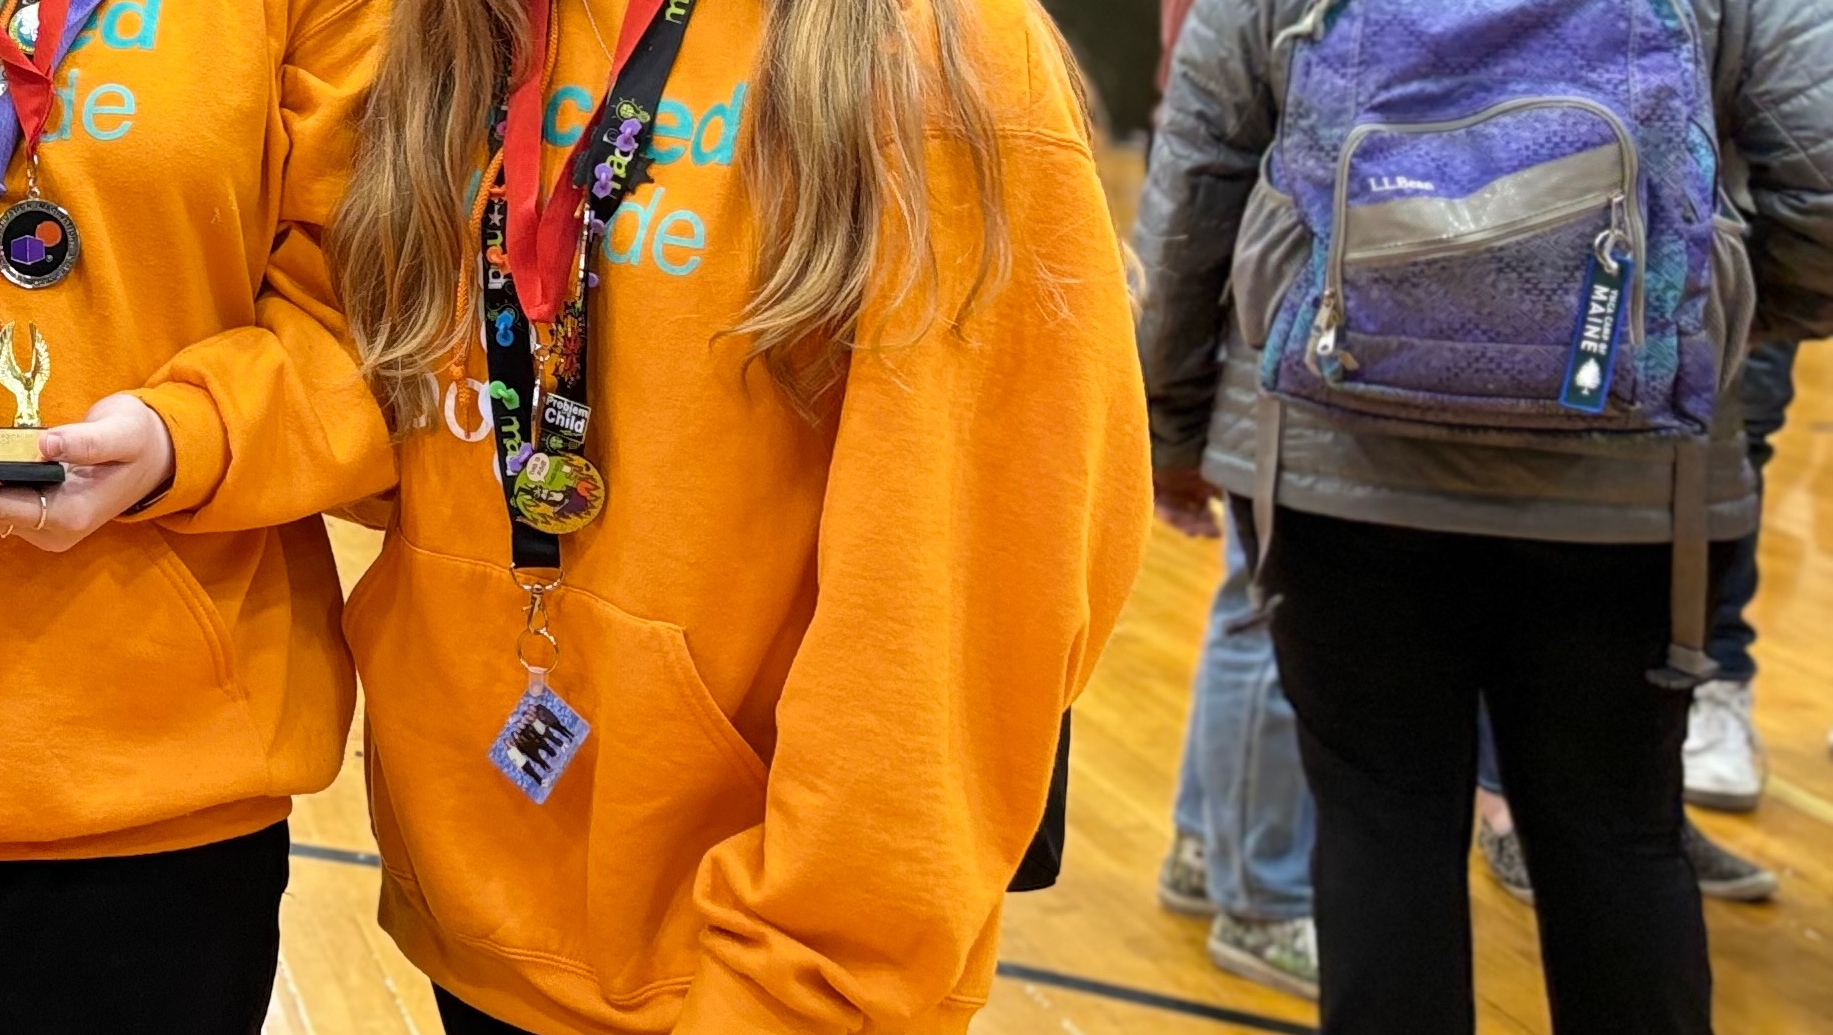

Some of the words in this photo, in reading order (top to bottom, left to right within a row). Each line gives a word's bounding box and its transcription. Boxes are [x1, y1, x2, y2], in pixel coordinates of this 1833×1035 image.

[1580, 284, 1610, 354] MAINE
[546, 394, 589, 419] Problem
[544, 407, 586, 434] Child
